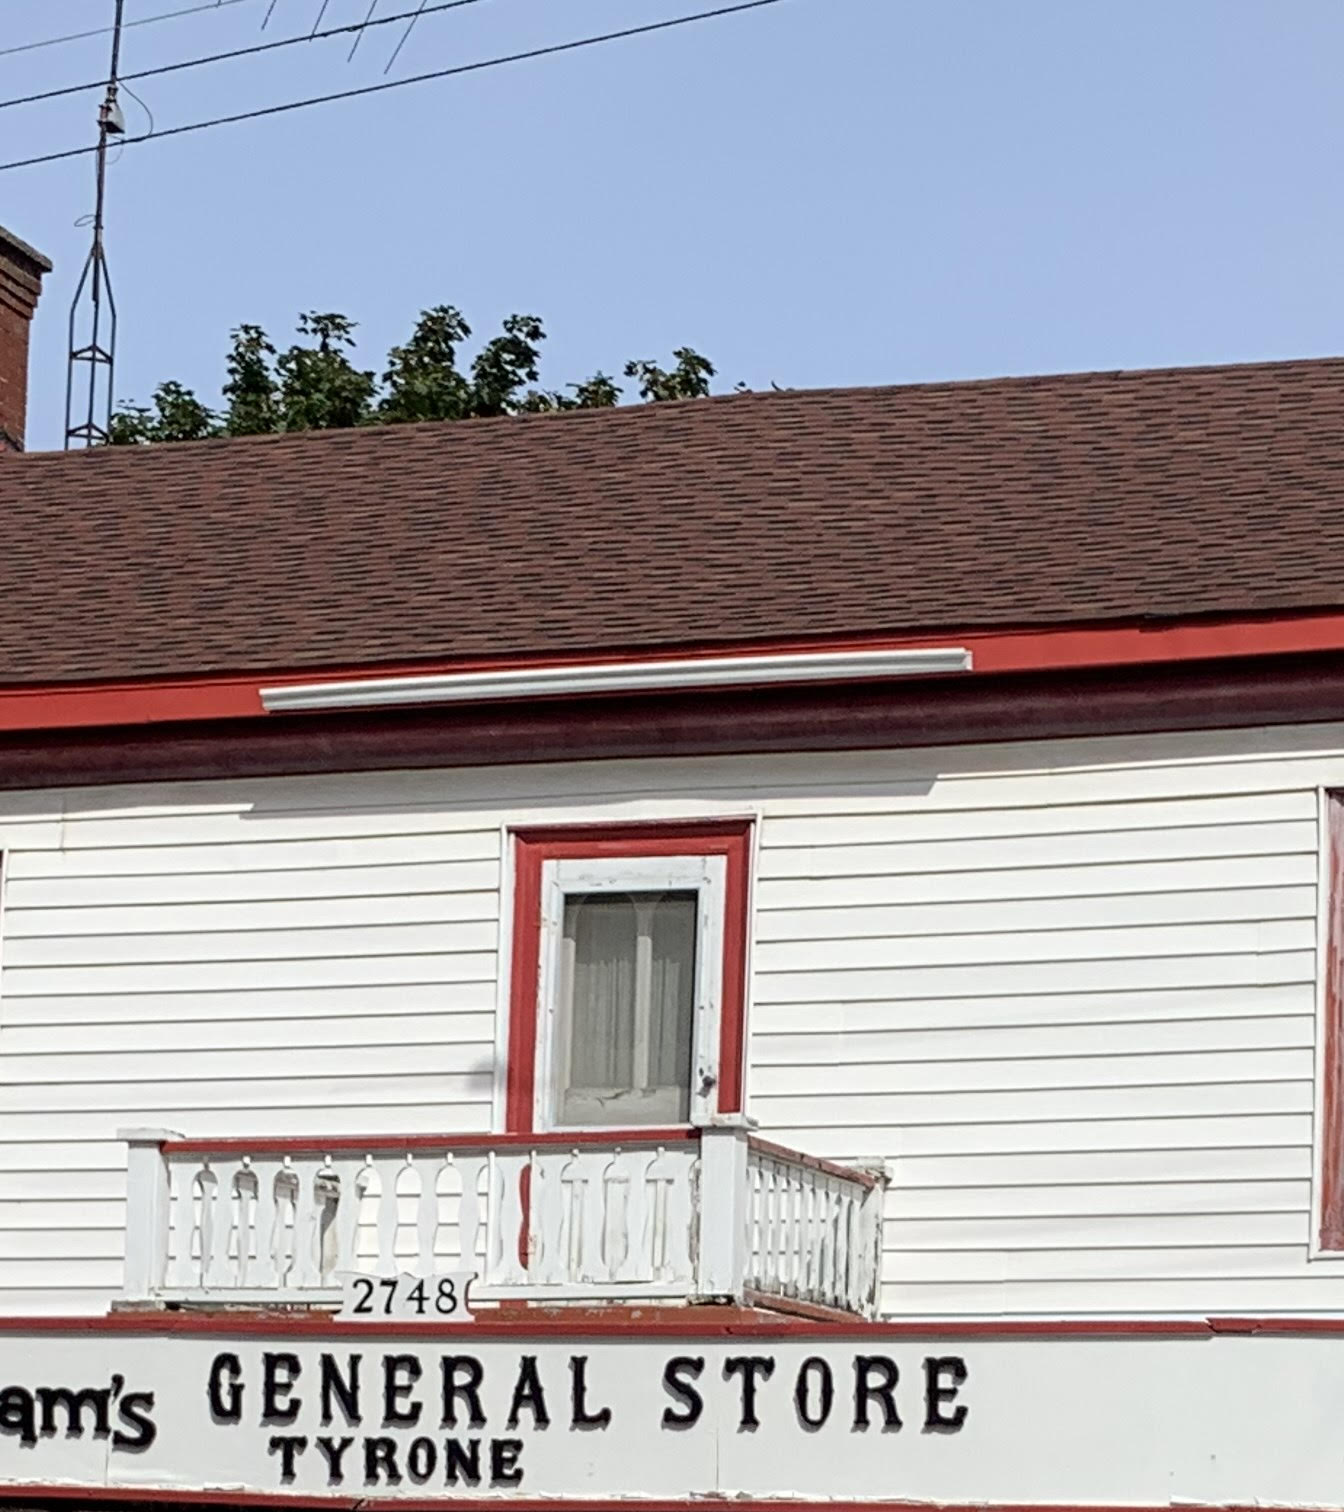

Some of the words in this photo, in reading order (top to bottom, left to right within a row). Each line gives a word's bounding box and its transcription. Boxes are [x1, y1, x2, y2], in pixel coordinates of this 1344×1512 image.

[352, 1277, 458, 1315] 2748
[208, 1352, 612, 1432] GENERAL
[660, 1355, 969, 1434] STORE
[268, 1436, 524, 1487] TYRONE
